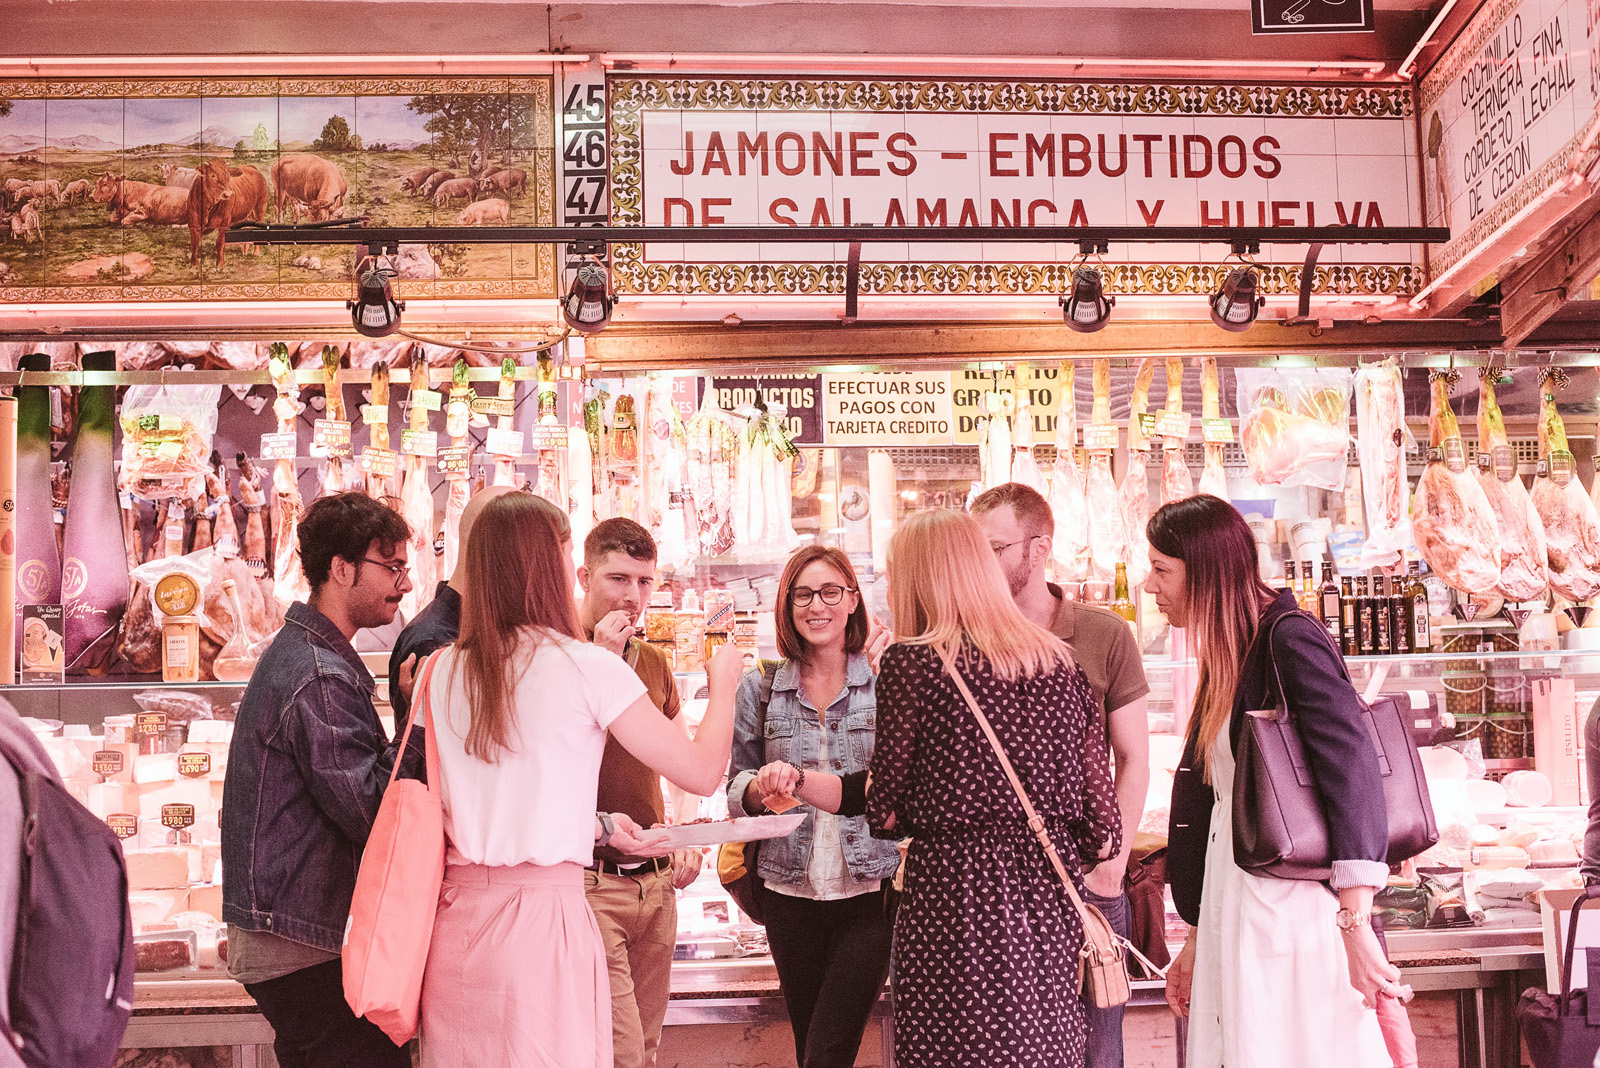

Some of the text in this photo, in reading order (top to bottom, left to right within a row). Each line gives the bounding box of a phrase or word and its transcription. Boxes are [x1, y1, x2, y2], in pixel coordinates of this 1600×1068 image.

[1461, 14, 1522, 107] COCHINILLO
[1472, 57, 1523, 135] TERNERA
[1533, 16, 1563, 75] FINA
[564, 84, 605, 122] 45
[1464, 111, 1513, 184] CORDERO
[1522, 53, 1575, 129] LECHAL
[564, 131, 605, 168] 46
[670, 131, 917, 177] JAMONES
[988, 132, 1282, 179] EMBUTIDOS
[566, 177, 606, 214] 47
[1469, 136, 1531, 221] DE CEBON
[829, 381, 946, 395] EFECTUAR SUS
[840, 401, 935, 414] PAGOS CON
[828, 420, 887, 434] TARJETA
[890, 420, 949, 434] CREDITO
